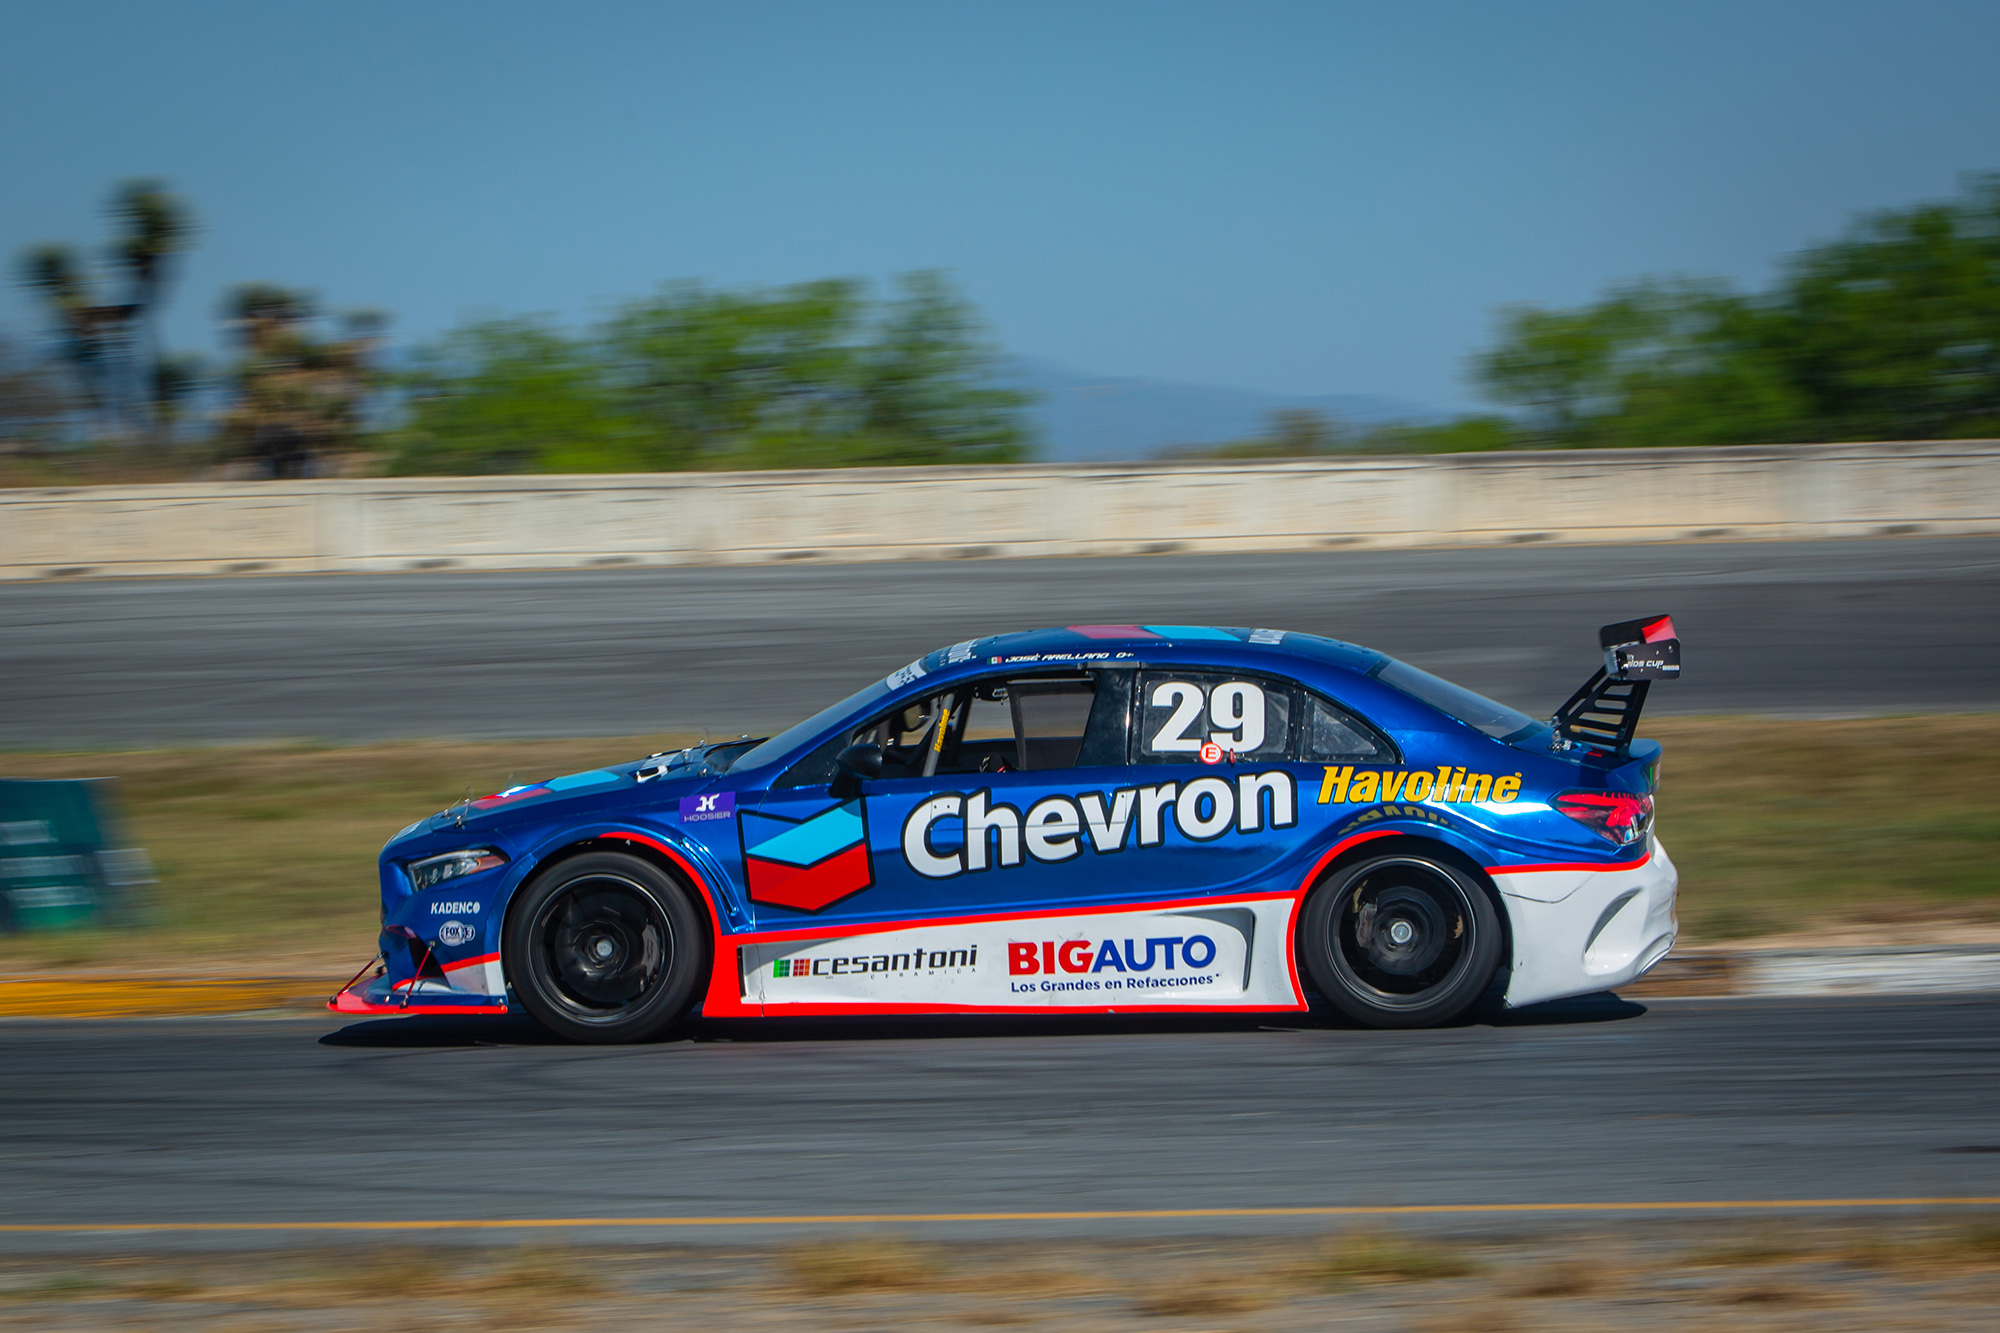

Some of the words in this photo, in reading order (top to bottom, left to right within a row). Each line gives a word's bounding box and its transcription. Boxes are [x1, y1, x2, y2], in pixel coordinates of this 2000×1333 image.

[1041, 652, 1110, 662] ARELLANO
[1152, 682, 1265, 753] 29
[933, 708, 950, 753] Havoline
[1205, 747, 1217, 760] E
[1317, 765, 1523, 805] Havoline
[684, 811, 731, 822] HOOSIER
[903, 769, 1295, 878] Chevron
[430, 901, 481, 915] KADENCO
[445, 926, 461, 938] FOX
[812, 944, 978, 976] cesantoni
[1011, 982, 1036, 993] Los
[1041, 979, 1101, 992] Grandes
[1105, 980, 1123, 990] en
[1127, 975, 1214, 989] Refacciones
